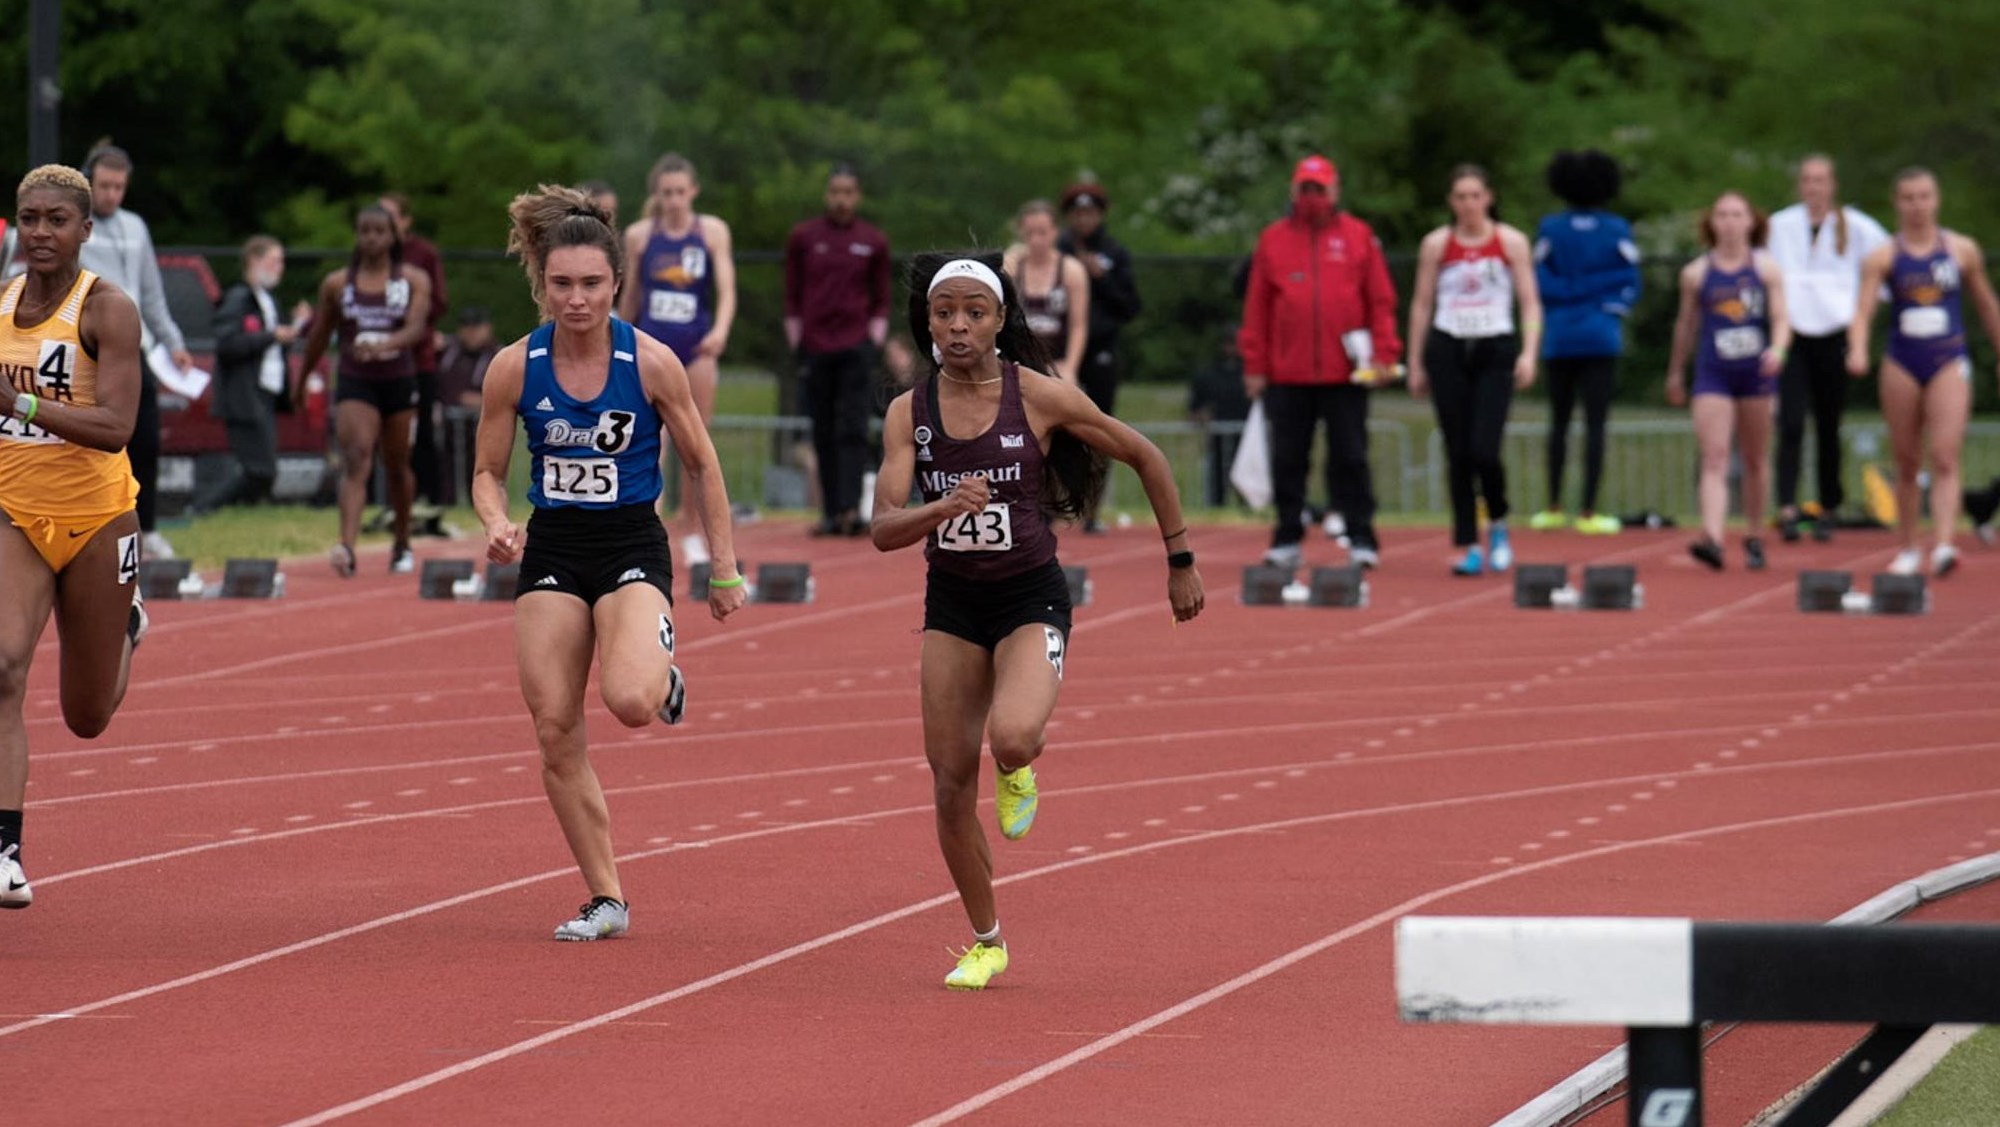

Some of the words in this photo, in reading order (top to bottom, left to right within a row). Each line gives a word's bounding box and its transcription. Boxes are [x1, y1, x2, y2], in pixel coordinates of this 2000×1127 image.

[39, 344, 70, 389] 4
[597, 412, 632, 452] 3
[549, 462, 612, 494] 125
[941, 511, 1005, 544] 243
[121, 536, 136, 581] 4
